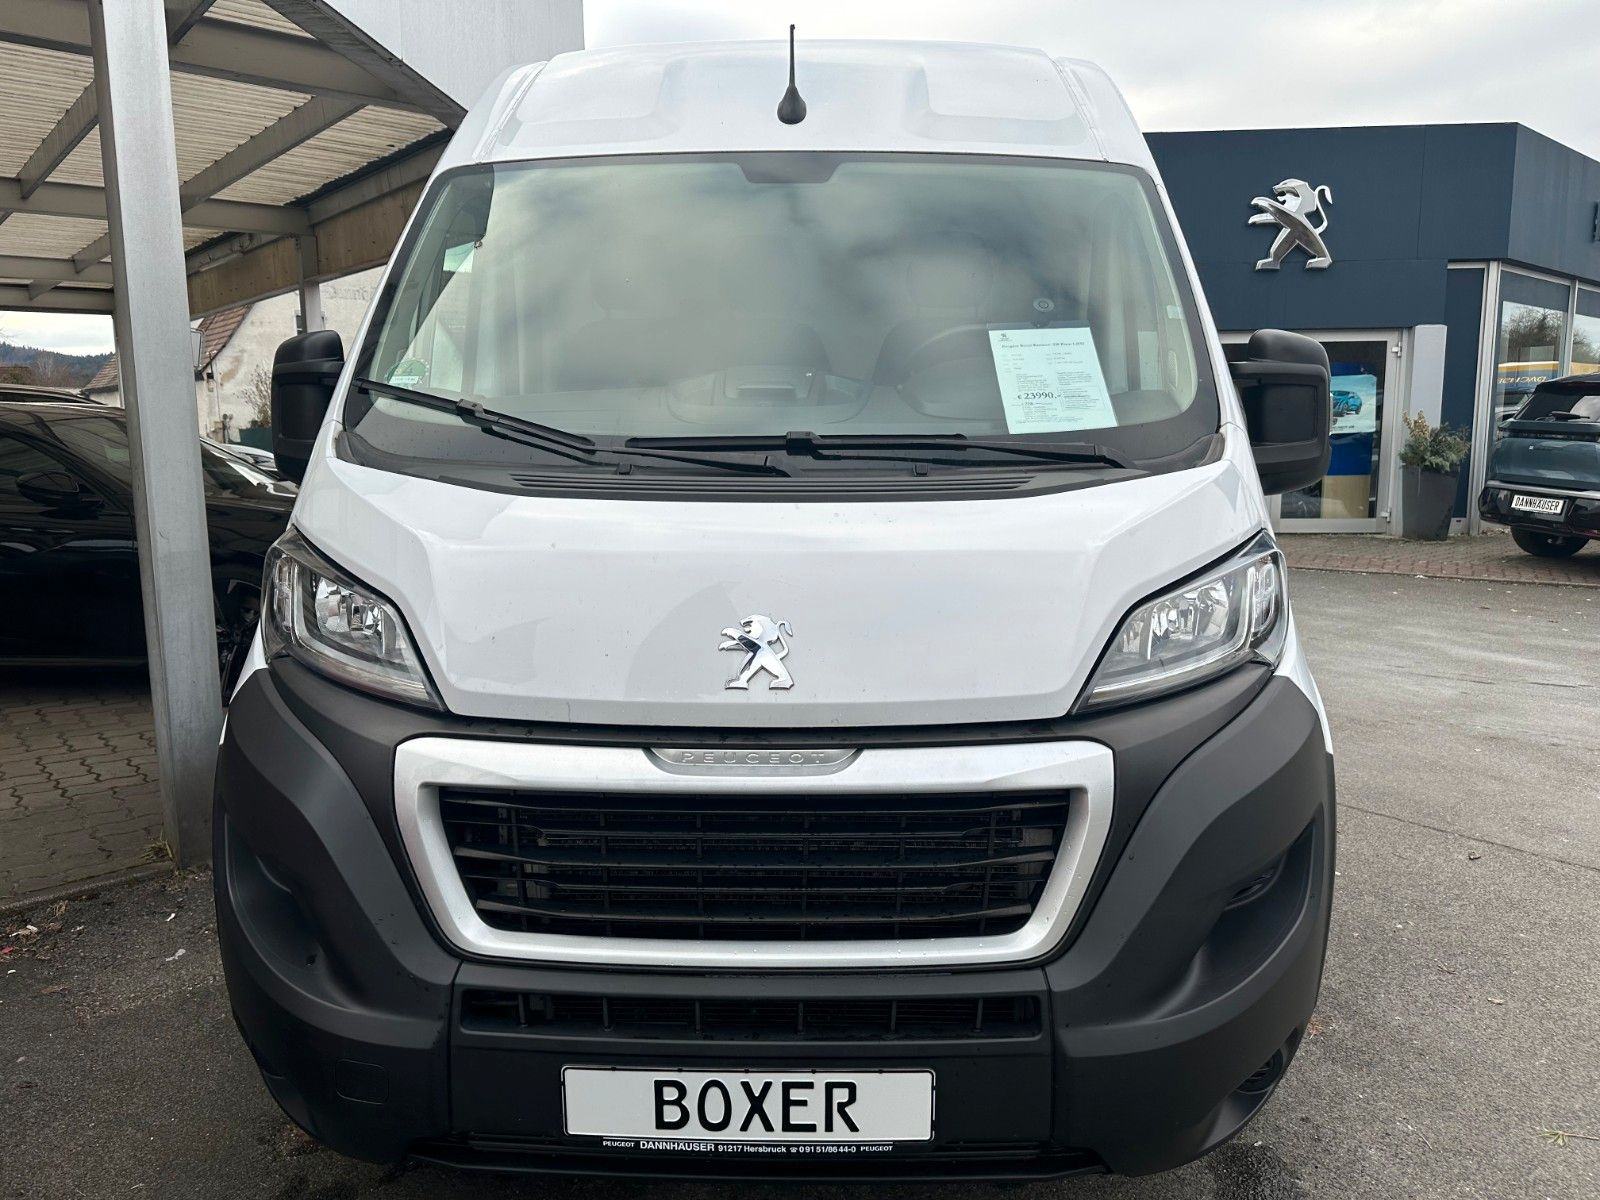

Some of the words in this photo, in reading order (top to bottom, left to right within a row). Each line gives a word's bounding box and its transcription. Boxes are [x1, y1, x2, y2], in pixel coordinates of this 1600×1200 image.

[681, 751, 825, 764] PEUGEOT
[653, 1079, 860, 1132] BOXER
[602, 1140, 635, 1148] PEUGEOT
[640, 1139, 715, 1152] DANNHÄUSER
[717, 1144, 743, 1152] 91217
[743, 1145, 787, 1153] Hersbruck
